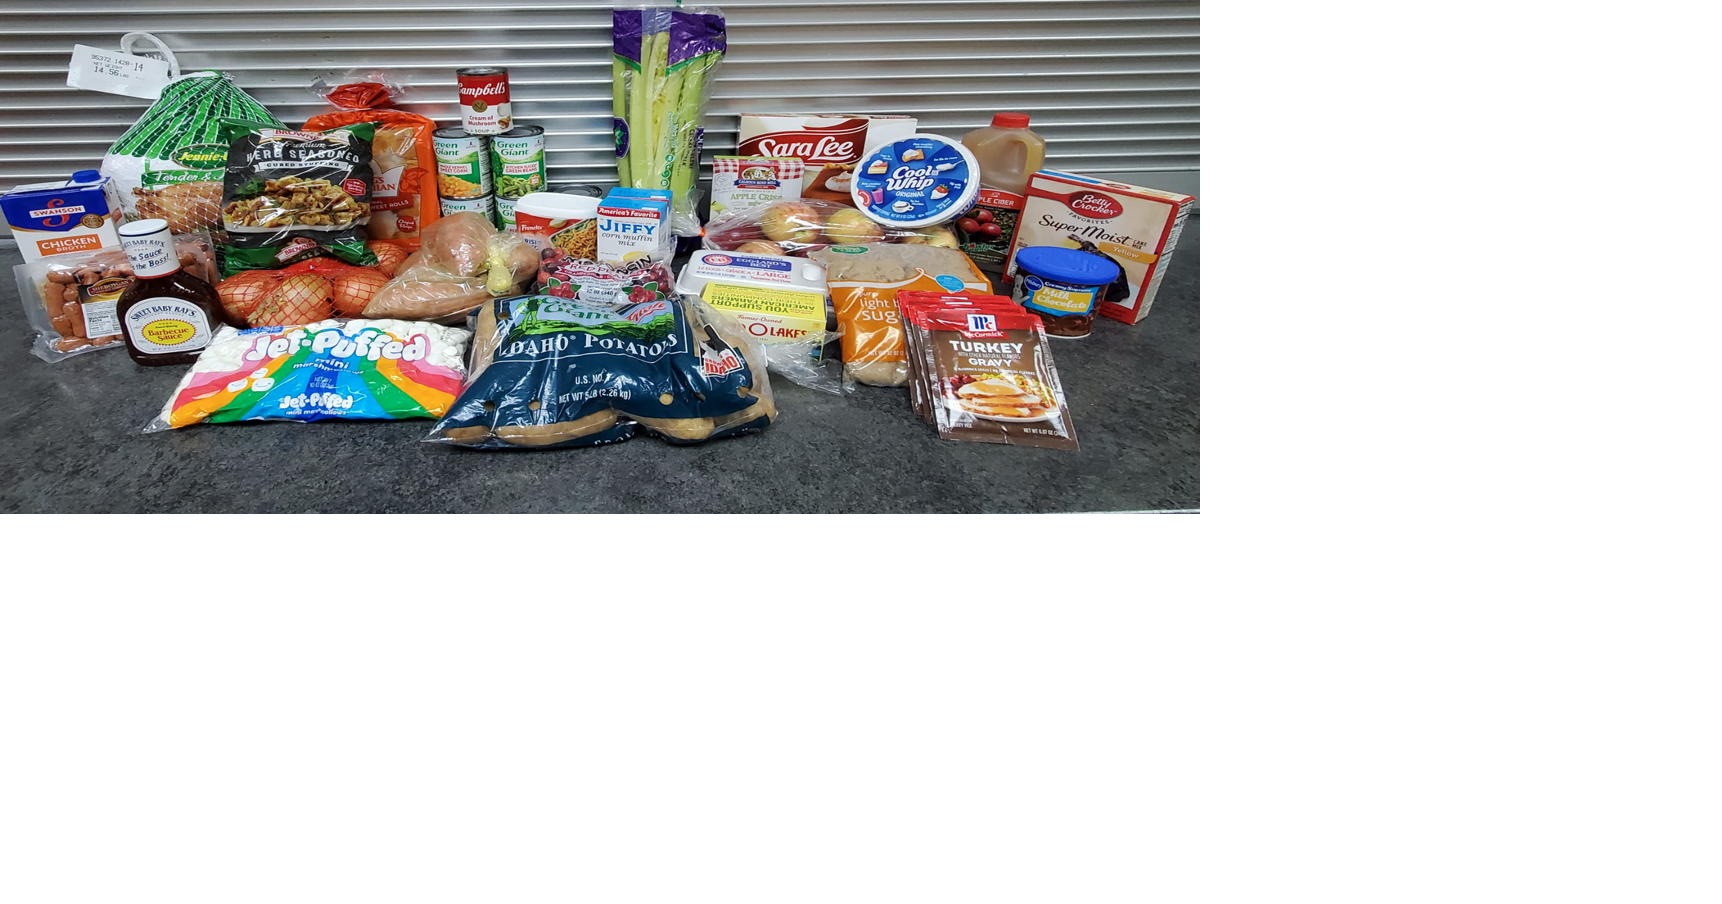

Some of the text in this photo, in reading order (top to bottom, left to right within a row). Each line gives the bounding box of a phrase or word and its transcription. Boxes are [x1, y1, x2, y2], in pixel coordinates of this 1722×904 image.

[91, 54, 112, 63] 95372
[458, 82, 506, 98] Campbell's
[434, 140, 458, 149] Green
[496, 140, 528, 149] Green
[758, 136, 854, 161] Sara Lee
[246, 150, 360, 163] HERB SEASONED
[436, 148, 459, 156] Giant
[500, 148, 529, 156] Giant
[152, 172, 198, 182] Tender
[892, 166, 933, 180] Cool
[886, 176, 934, 191] Whip
[896, 190, 925, 198] ORIGINAL
[389, 200, 409, 208] ROLLS
[441, 201, 467, 211] Green
[993, 198, 1015, 207] CIDER
[1082, 194, 1113, 210] Betty
[34, 206, 82, 217] SWANSON
[598, 208, 658, 218] America's Favorite
[1072, 200, 1114, 216] Crocker
[1067, 210, 1111, 225] FAVORITES
[599, 219, 657, 235] JIFFY
[41, 236, 97, 250] CHICKEN
[623, 234, 653, 242] muffin
[56, 244, 87, 252] BROTH
[1113, 246, 1140, 259] Yellow
[138, 248, 163, 261] Sauce
[136, 253, 170, 271] the Boss!
[736, 258, 787, 267] EGGLAND'S
[756, 271, 791, 279] LARGE
[1042, 288, 1070, 301] Milk
[709, 300, 789, 313] YOU SUPPORT
[712, 295, 815, 310] AMERICAN FARMERS
[860, 298, 893, 310] light
[1036, 295, 1088, 310] Chocolate
[174, 306, 197, 317] RAY'S
[862, 309, 900, 324] sug
[737, 314, 783, 325] Farmer-Owned
[148, 328, 190, 337] Barbecue
[157, 334, 183, 342] Sauce
[245, 330, 427, 362] Jet-Puffed
[949, 340, 1023, 354] TURKEY
[315, 358, 350, 369] mini
[968, 358, 1012, 367] GRAVY
[575, 376, 591, 385] U.S.
[558, 394, 571, 404] NET
[572, 392, 583, 402] WT
[598, 388, 618, 397] (2.26
[620, 389, 632, 400] kg)
